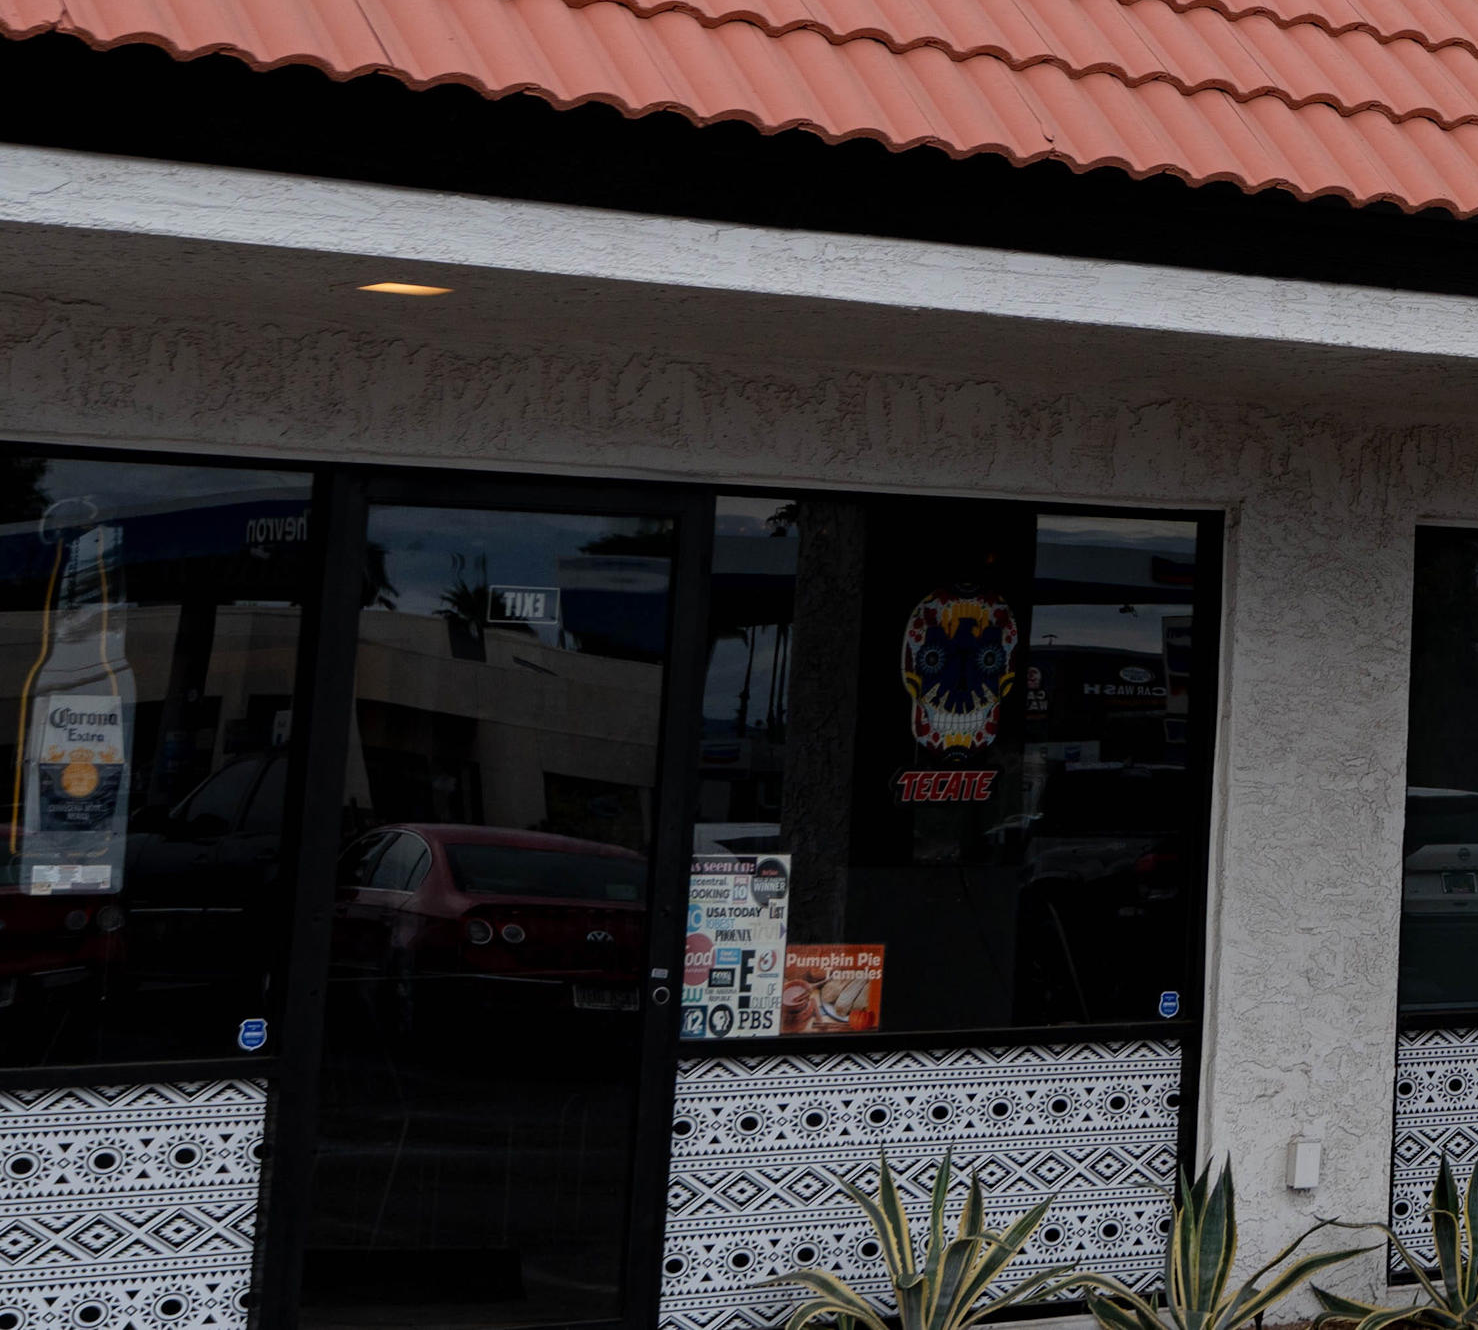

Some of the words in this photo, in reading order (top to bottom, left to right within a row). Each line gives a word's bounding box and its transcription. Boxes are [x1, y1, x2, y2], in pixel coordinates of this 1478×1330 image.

[49, 708, 118, 729] Corona
[67, 729, 105, 742] Extra
[896, 770, 999, 802] TECATE
[703, 860, 732, 872] seen
[753, 881, 786, 893] WINNER
[689, 888, 731, 900] OOKING
[706, 907, 727, 918] USA
[728, 906, 762, 918] TODAY
[715, 930, 752, 942] PHOENIX
[684, 945, 714, 966] ood
[786, 953, 854, 970] Pumpkin
[857, 952, 881, 967] Pie
[824, 966, 882, 980] Tamales
[738, 1010, 773, 1030] PBS
